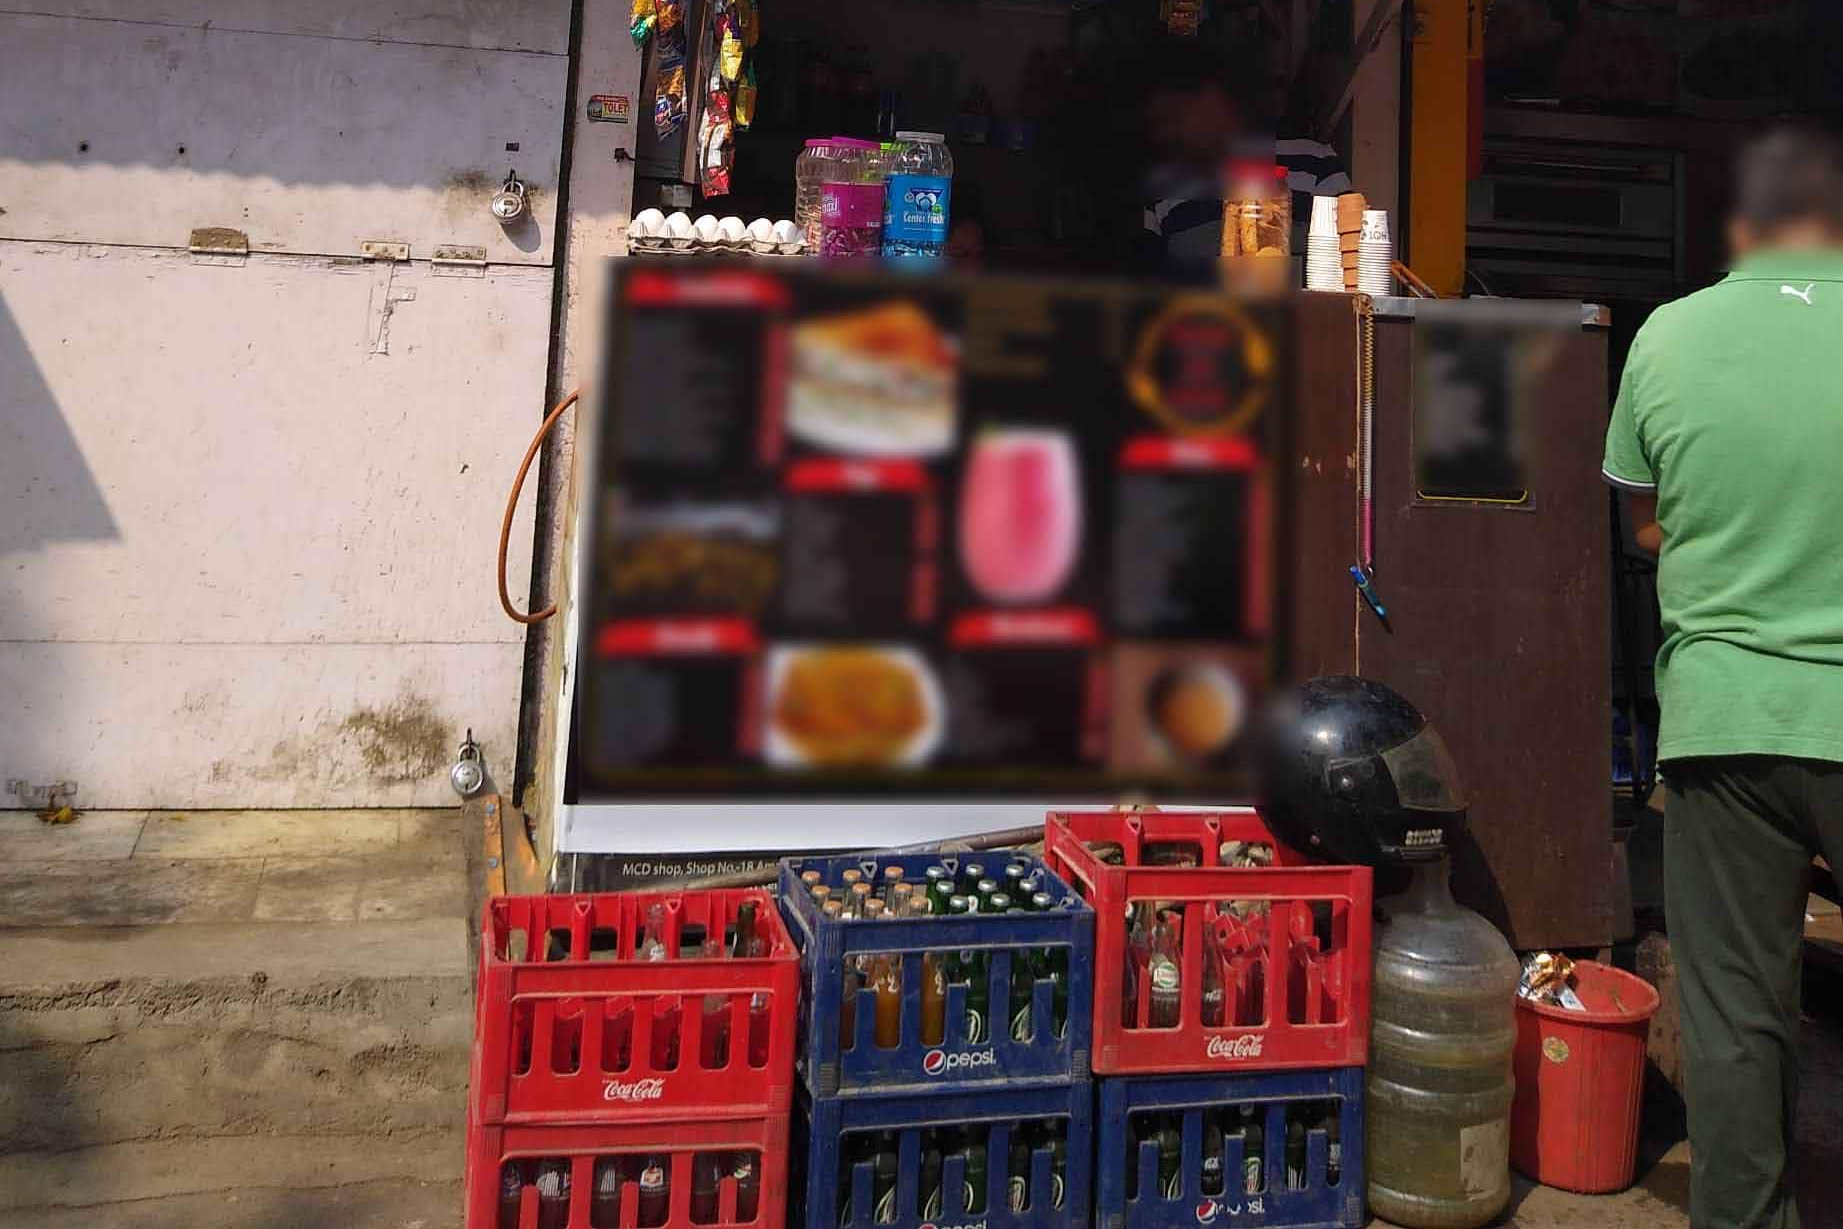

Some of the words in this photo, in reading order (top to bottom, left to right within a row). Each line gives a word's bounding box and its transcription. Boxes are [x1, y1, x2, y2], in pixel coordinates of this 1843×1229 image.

[623, 862, 652, 876] MCD
[653, 861, 684, 878] shop,
[687, 860, 716, 877] Shop
[946, 1048, 994, 1071] pepsi
